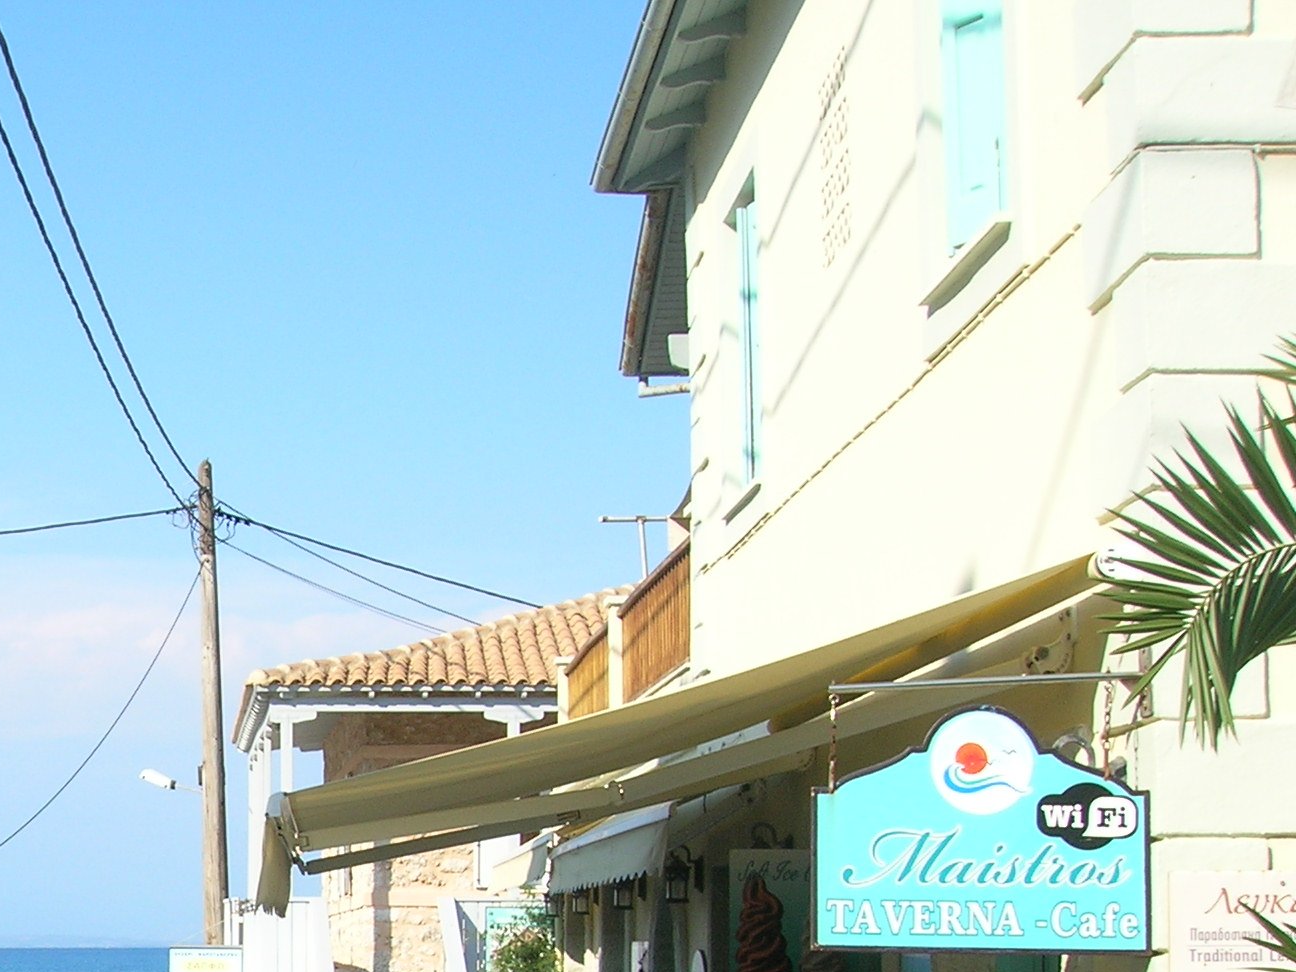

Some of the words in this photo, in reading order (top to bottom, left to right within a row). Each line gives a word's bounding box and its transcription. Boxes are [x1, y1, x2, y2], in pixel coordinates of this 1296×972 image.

[1040, 803, 1085, 829] Wi
[1096, 806, 1128, 828] Fi
[840, 828, 1127, 887] Maistros
[826, 898, 1025, 937] TAVERNA
[1189, 948, 1264, 963] Traditional
